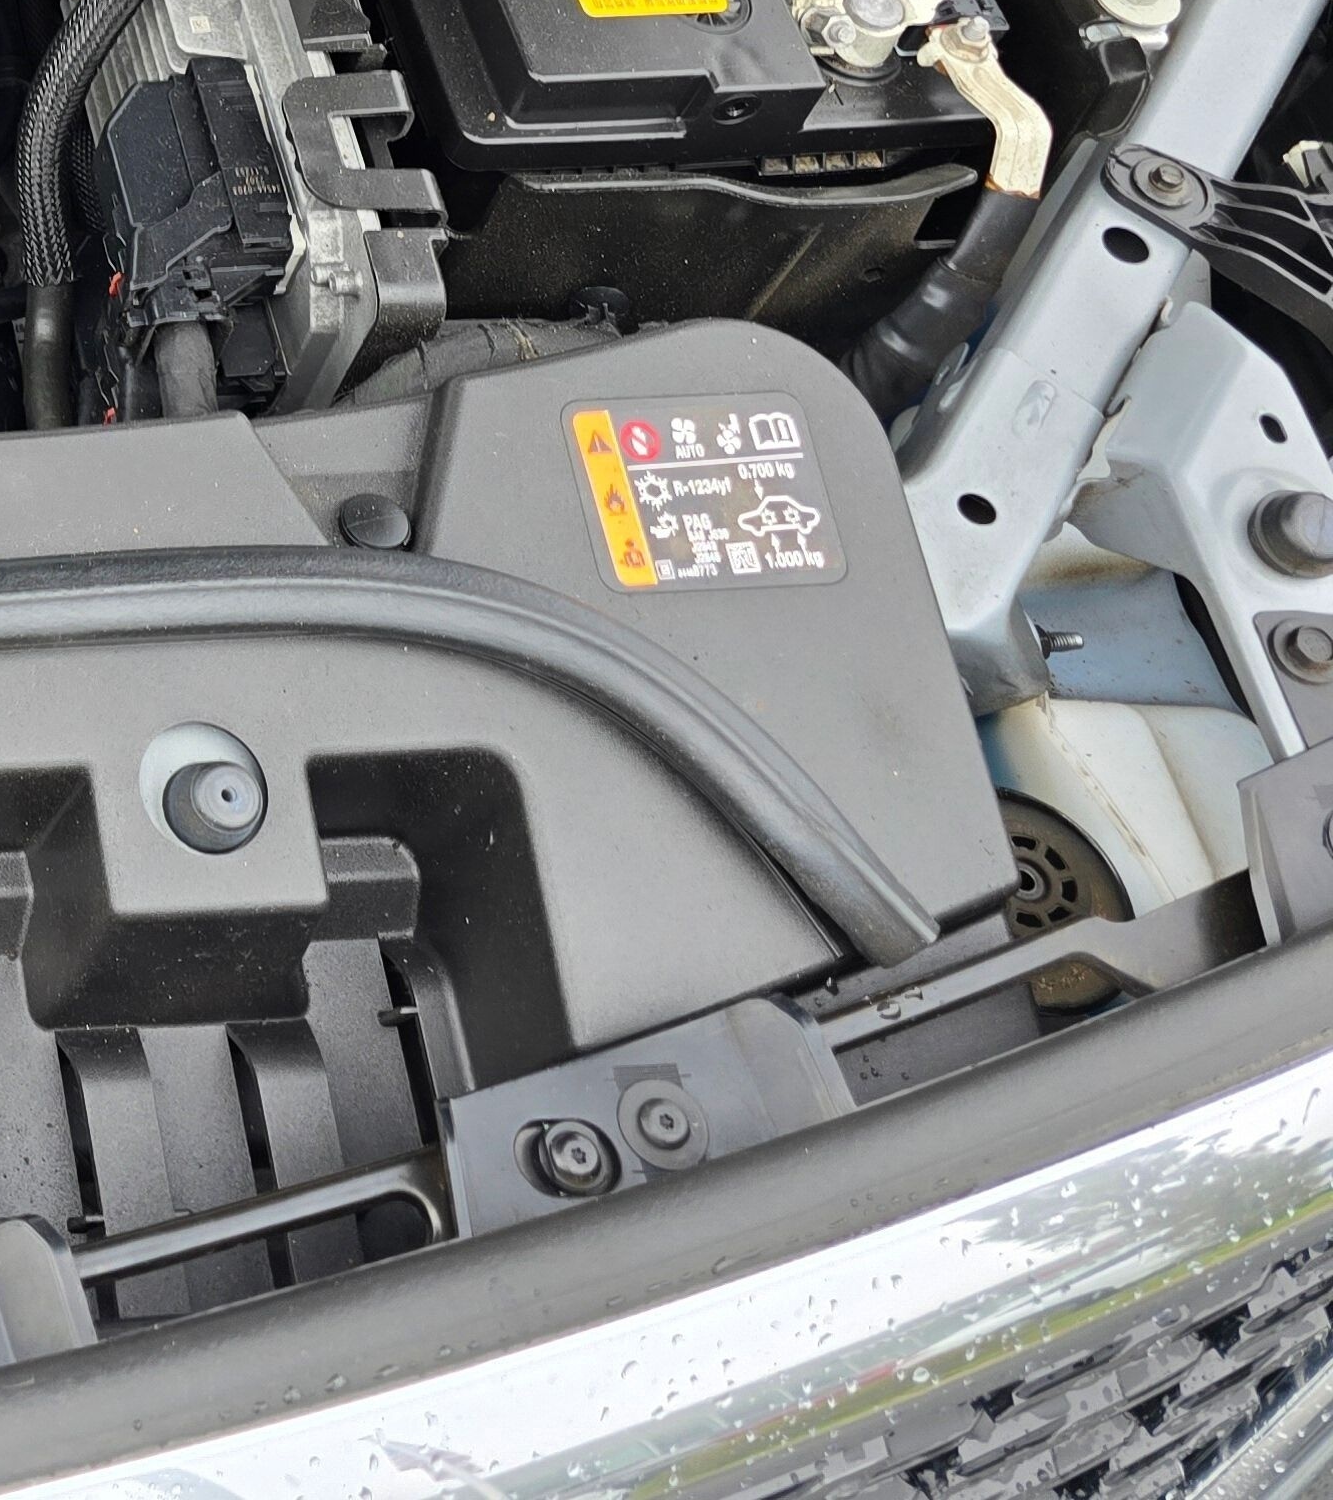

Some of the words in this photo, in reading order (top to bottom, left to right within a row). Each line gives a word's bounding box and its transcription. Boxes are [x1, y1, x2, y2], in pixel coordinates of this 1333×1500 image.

[675, 444, 705, 460] AUTO
[738, 463, 775, 480] 0.700
[775, 462, 795, 479] kg
[672, 477, 731, 497] R-1234yf
[682, 513, 712, 530] PAG
[765, 552, 804, 570] 1.000
[805, 551, 825, 568] kg
